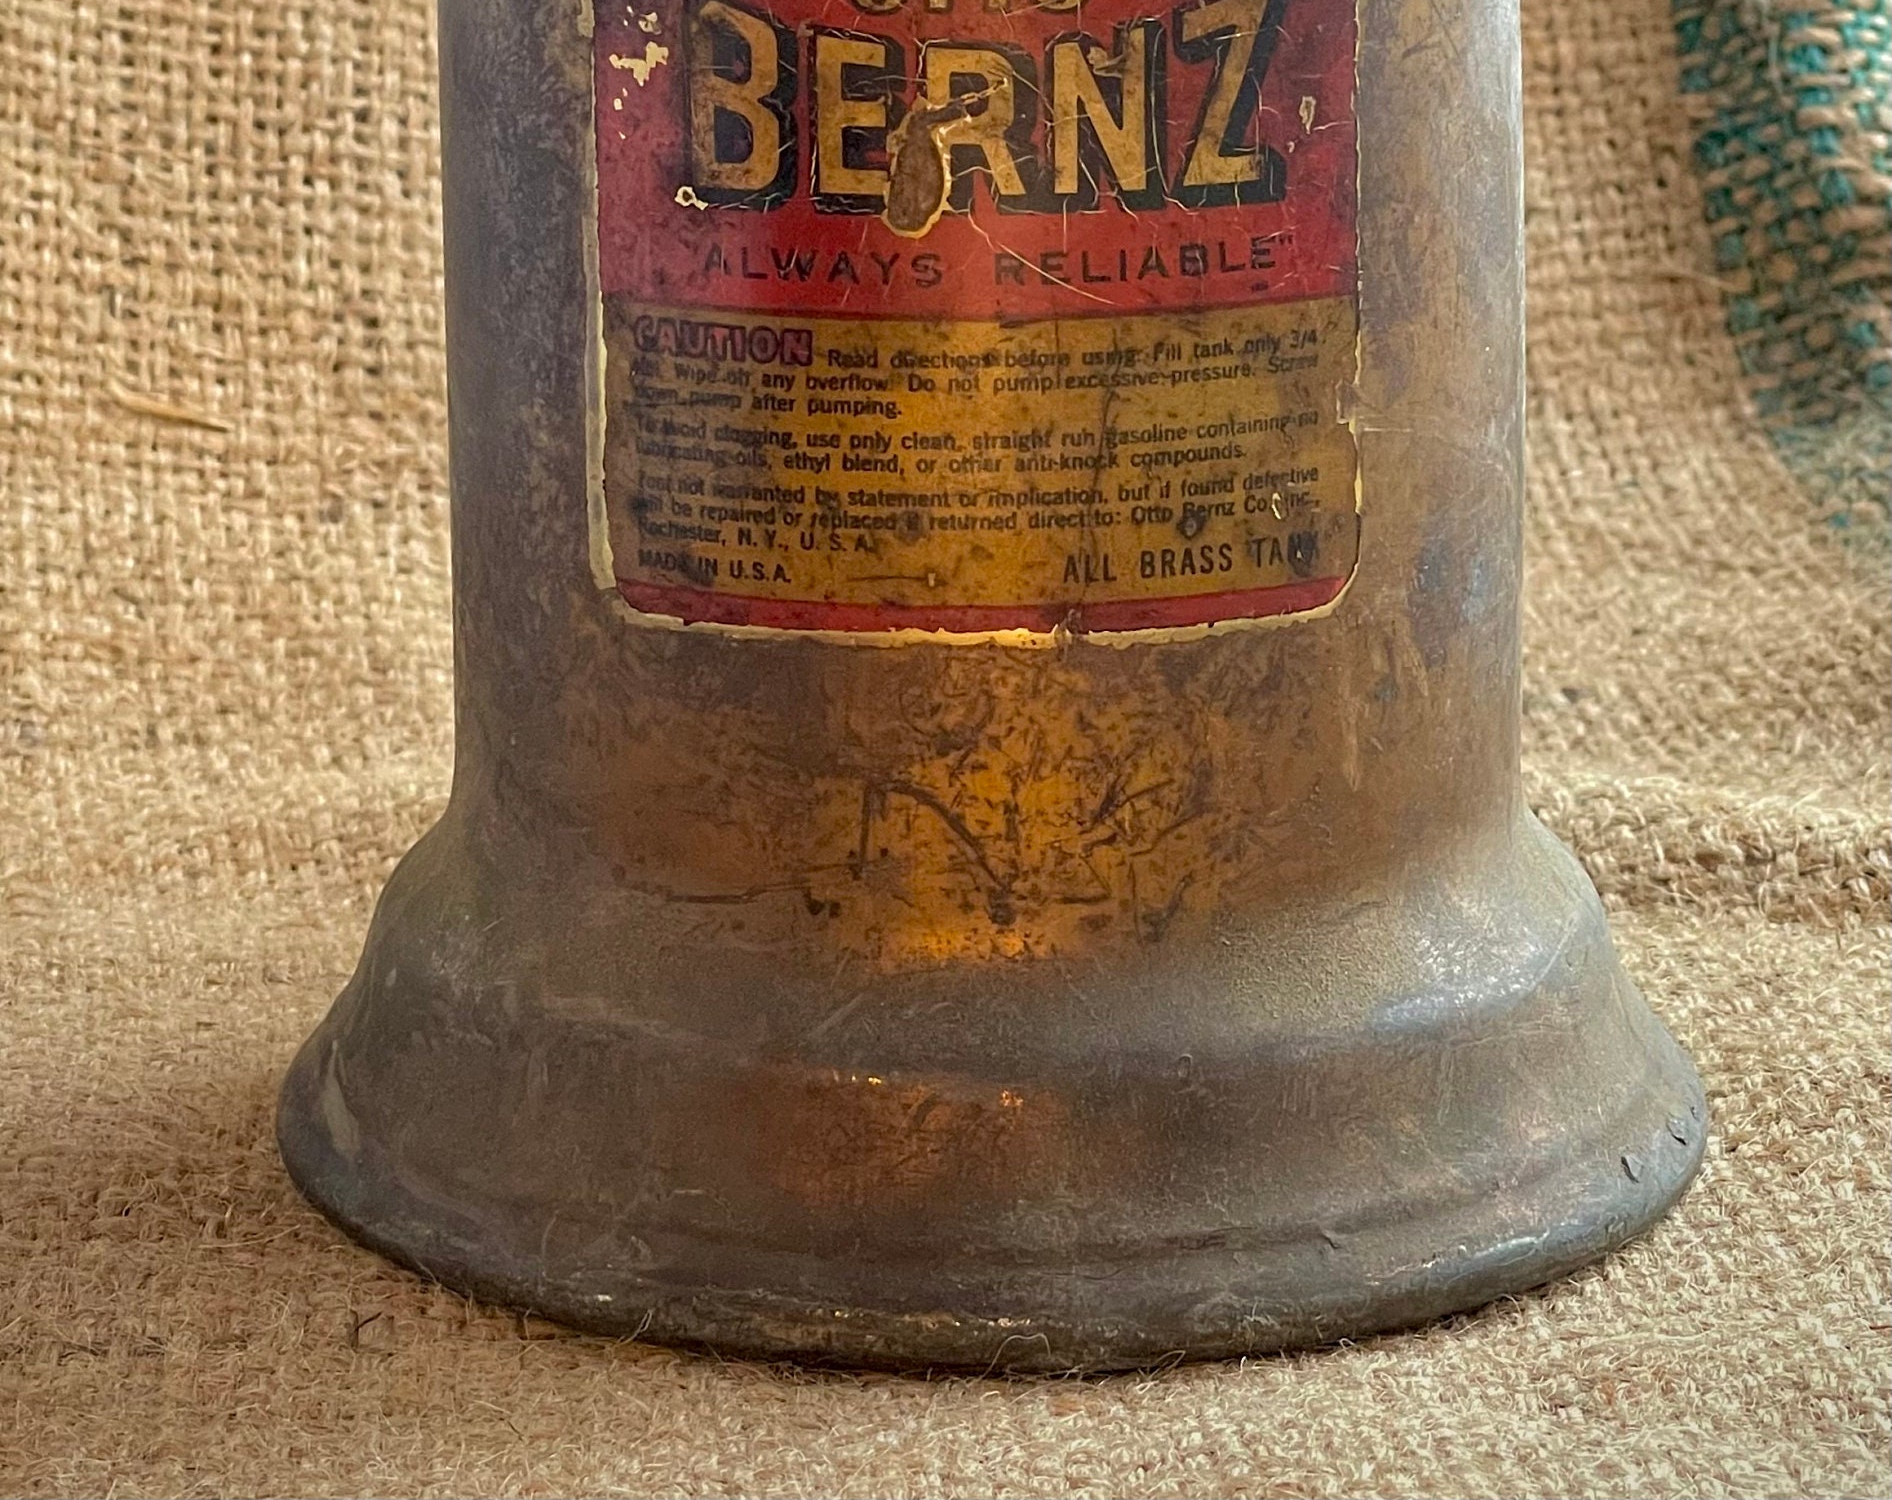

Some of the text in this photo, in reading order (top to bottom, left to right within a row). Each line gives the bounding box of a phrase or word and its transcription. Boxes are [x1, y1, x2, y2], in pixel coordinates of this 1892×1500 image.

[633, 315, 814, 367] CAUTION
[828, 349, 878, 368] Read
[1004, 349, 1070, 368] before
[1152, 341, 1181, 362] Fill
[1193, 337, 1234, 360] tank
[1244, 334, 1281, 356] only
[762, 373, 795, 392] any
[908, 374, 936, 392] Do
[948, 375, 980, 392] not
[993, 376, 1052, 395] pump
[752, 392, 796, 412] after
[807, 397, 902, 419] pumping.
[806, 432, 841, 449] use
[849, 430, 891, 453] only
[973, 427, 1050, 451] straight
[1061, 428, 1095, 447] run
[1105, 423, 1187, 448] gasoline
[1196, 415, 1290, 439] containing
[783, 452, 830, 474] ethyl
[842, 453, 904, 475] blend,
[916, 457, 937, 473] or
[949, 452, 1002, 473] other
[1014, 450, 1118, 472] anti-knock
[1130, 440, 1247, 468] compounds.
[848, 489, 950, 508] statement
[958, 491, 978, 508] or
[1118, 481, 1150, 501] but
[1160, 479, 1172, 499] if
[1181, 475, 1234, 498] found
[1243, 465, 1319, 491] defective
[671, 498, 692, 518] be
[700, 501, 776, 525] repaired
[783, 507, 804, 527] or
[810, 507, 896, 531] replaced
[929, 510, 1017, 531] returned
[1028, 509, 1085, 530] direct
[1094, 509, 1122, 527] to:
[1131, 505, 1173, 525] Otto
[1181, 499, 1235, 525] Bernz
[738, 526, 758, 547] N.
[729, 559, 792, 583] U.S.A.
[1063, 553, 1117, 586] ALL
[1140, 543, 1233, 579] BRASS
